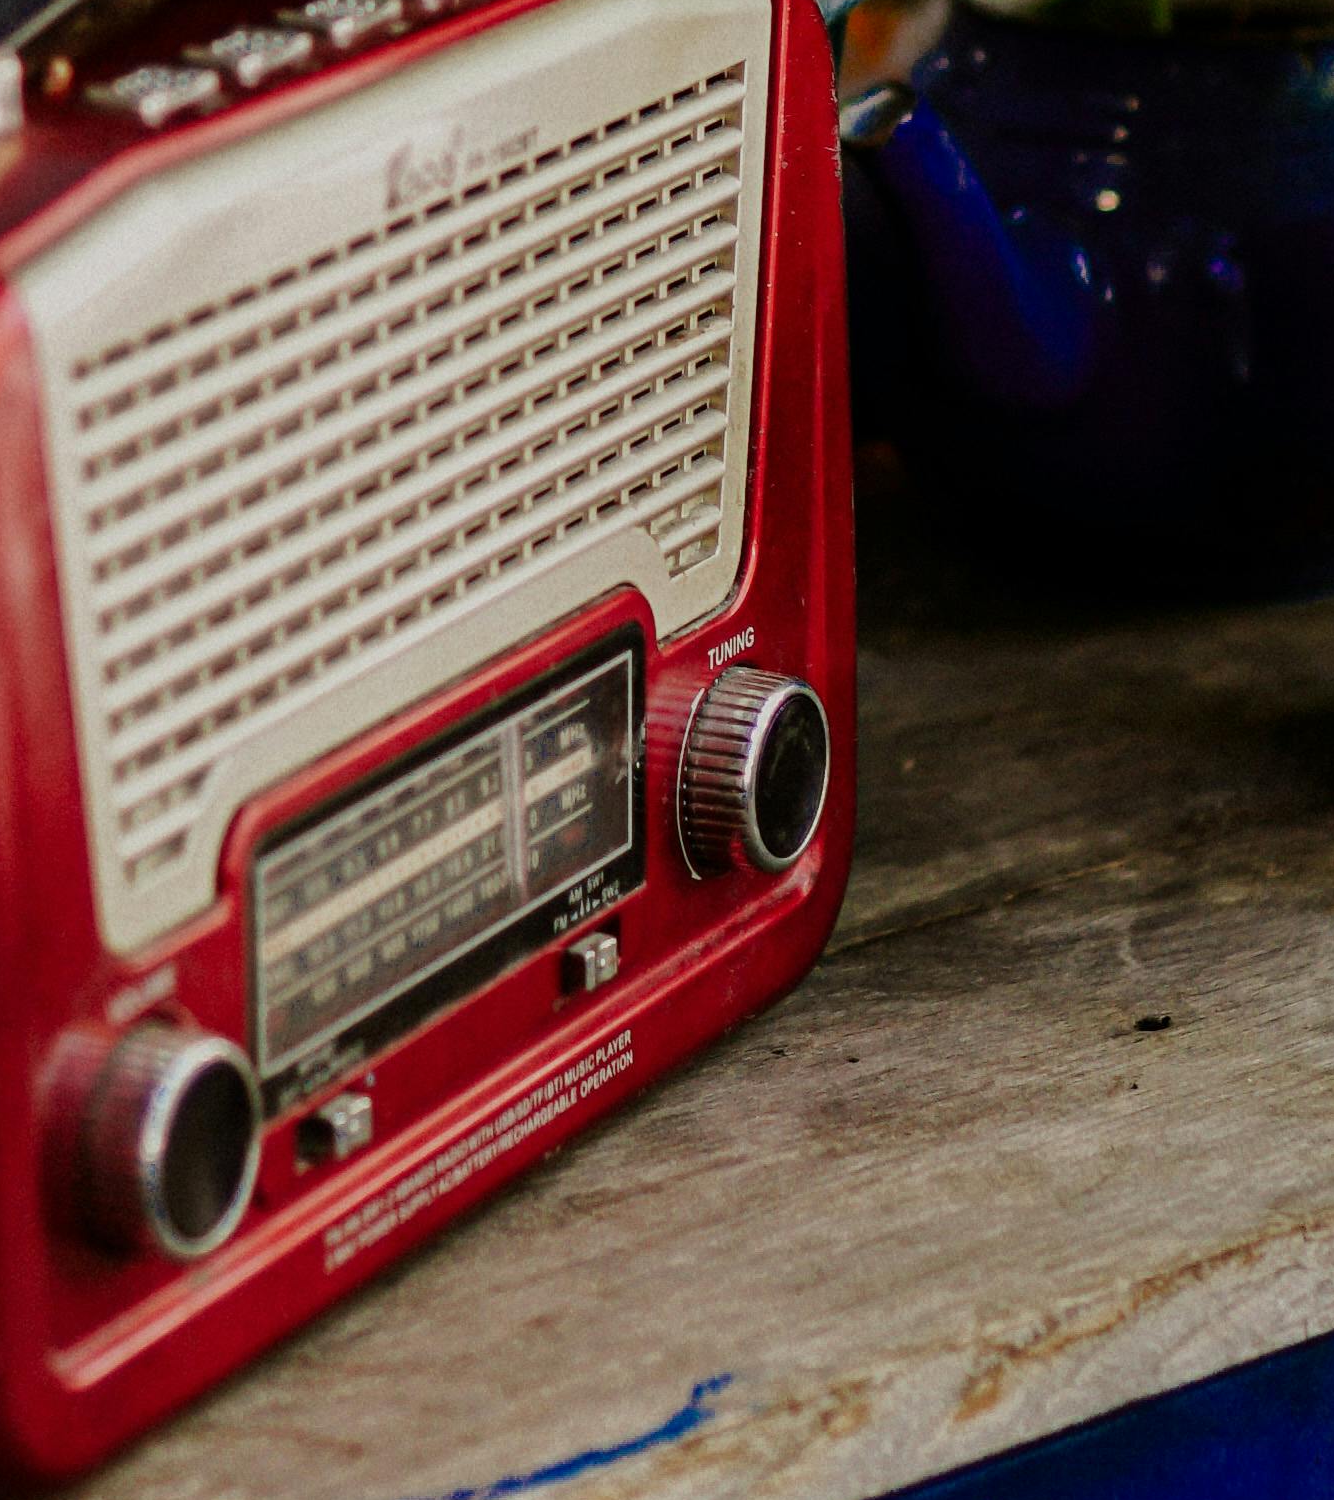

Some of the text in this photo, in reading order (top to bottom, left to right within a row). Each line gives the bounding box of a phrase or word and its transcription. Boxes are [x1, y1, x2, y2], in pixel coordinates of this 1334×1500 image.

[708, 626, 754, 670] TUNING
[561, 783, 587, 811] MHz
[569, 885, 583, 905] AM
[553, 914, 568, 934] FM
[564, 1054, 595, 1088] MUSIC
[596, 1029, 632, 1066] PLAYER
[580, 1049, 634, 1098] OPERATION
